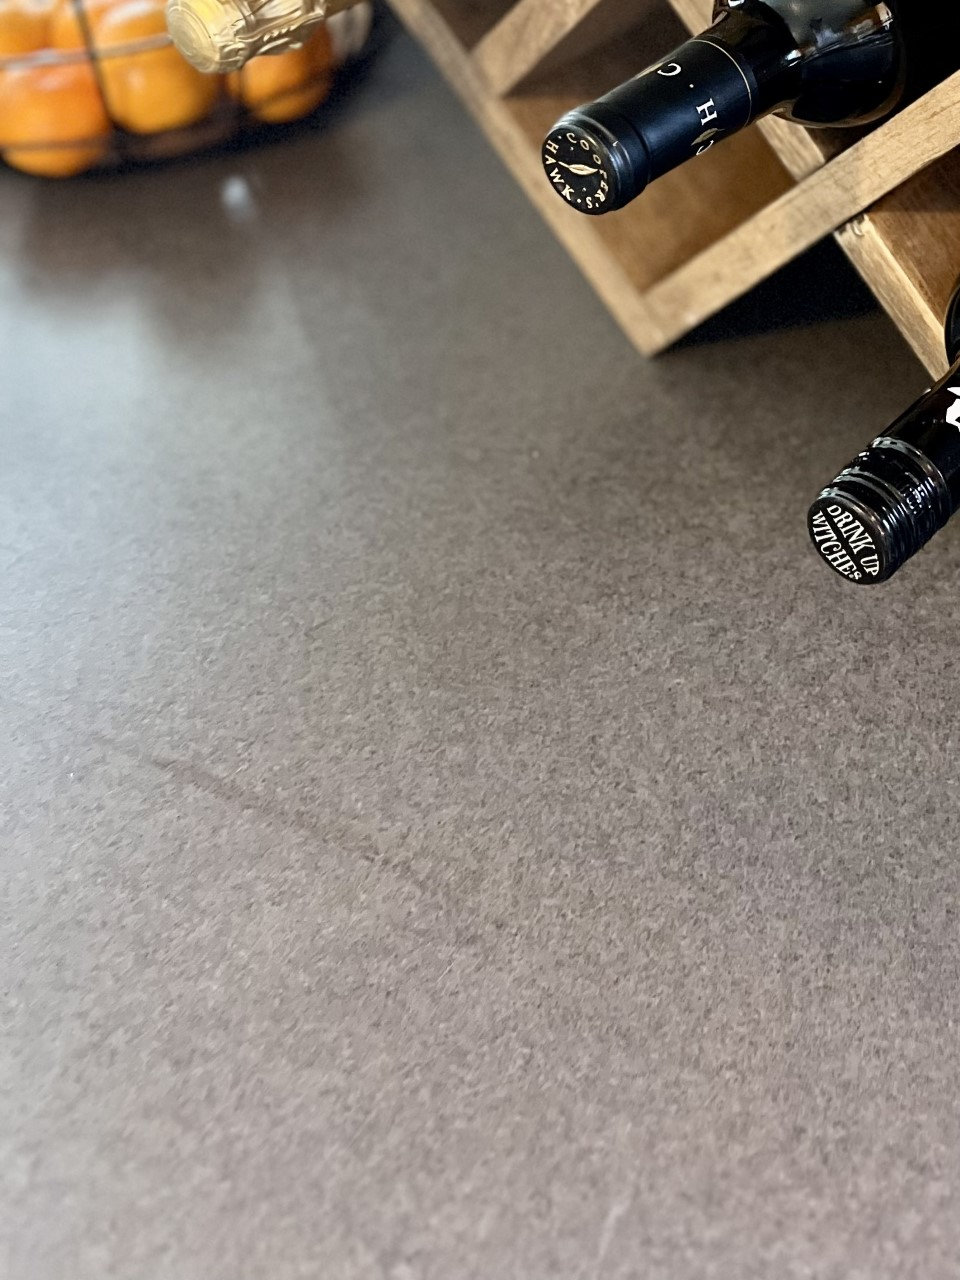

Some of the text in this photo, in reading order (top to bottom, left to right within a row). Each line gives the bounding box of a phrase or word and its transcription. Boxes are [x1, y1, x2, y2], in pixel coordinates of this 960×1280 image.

[544, 139, 575, 201] HAWK
[812, 510, 862, 580] WITCHES
[826, 504, 880, 576] DRINK UP
